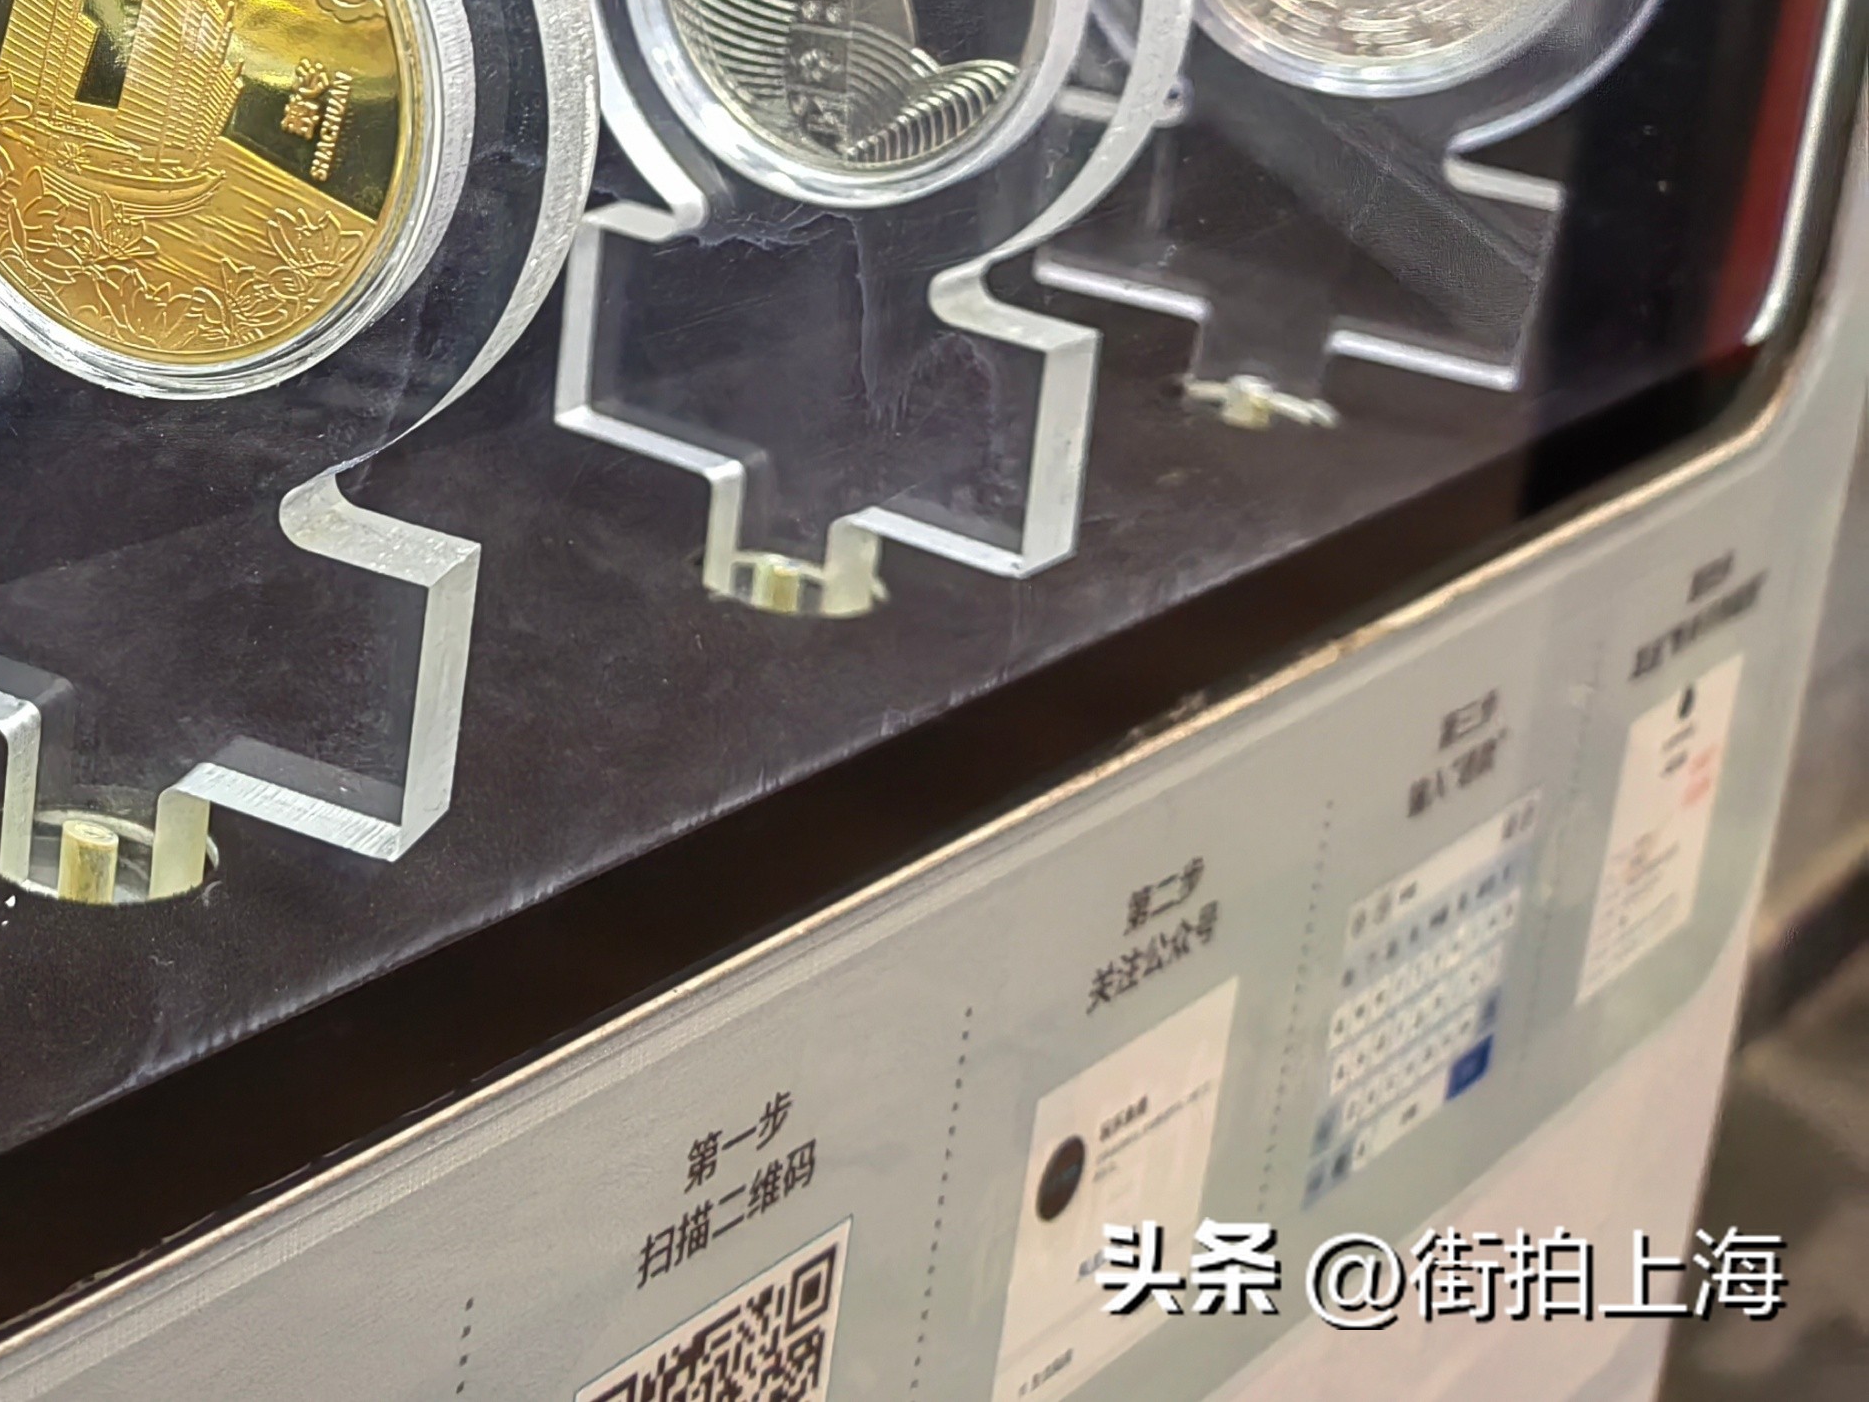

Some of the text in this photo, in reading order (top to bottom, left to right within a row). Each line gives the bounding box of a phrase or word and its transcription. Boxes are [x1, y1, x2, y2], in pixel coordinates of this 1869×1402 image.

[309, 70, 353, 182] SHACHUAN
[1123, 855, 1206, 937] 第二步
[1086, 899, 1219, 1015] 关注公众号
[684, 1091, 793, 1194] 第一步
[637, 1138, 817, 1289] 扫描二维码
